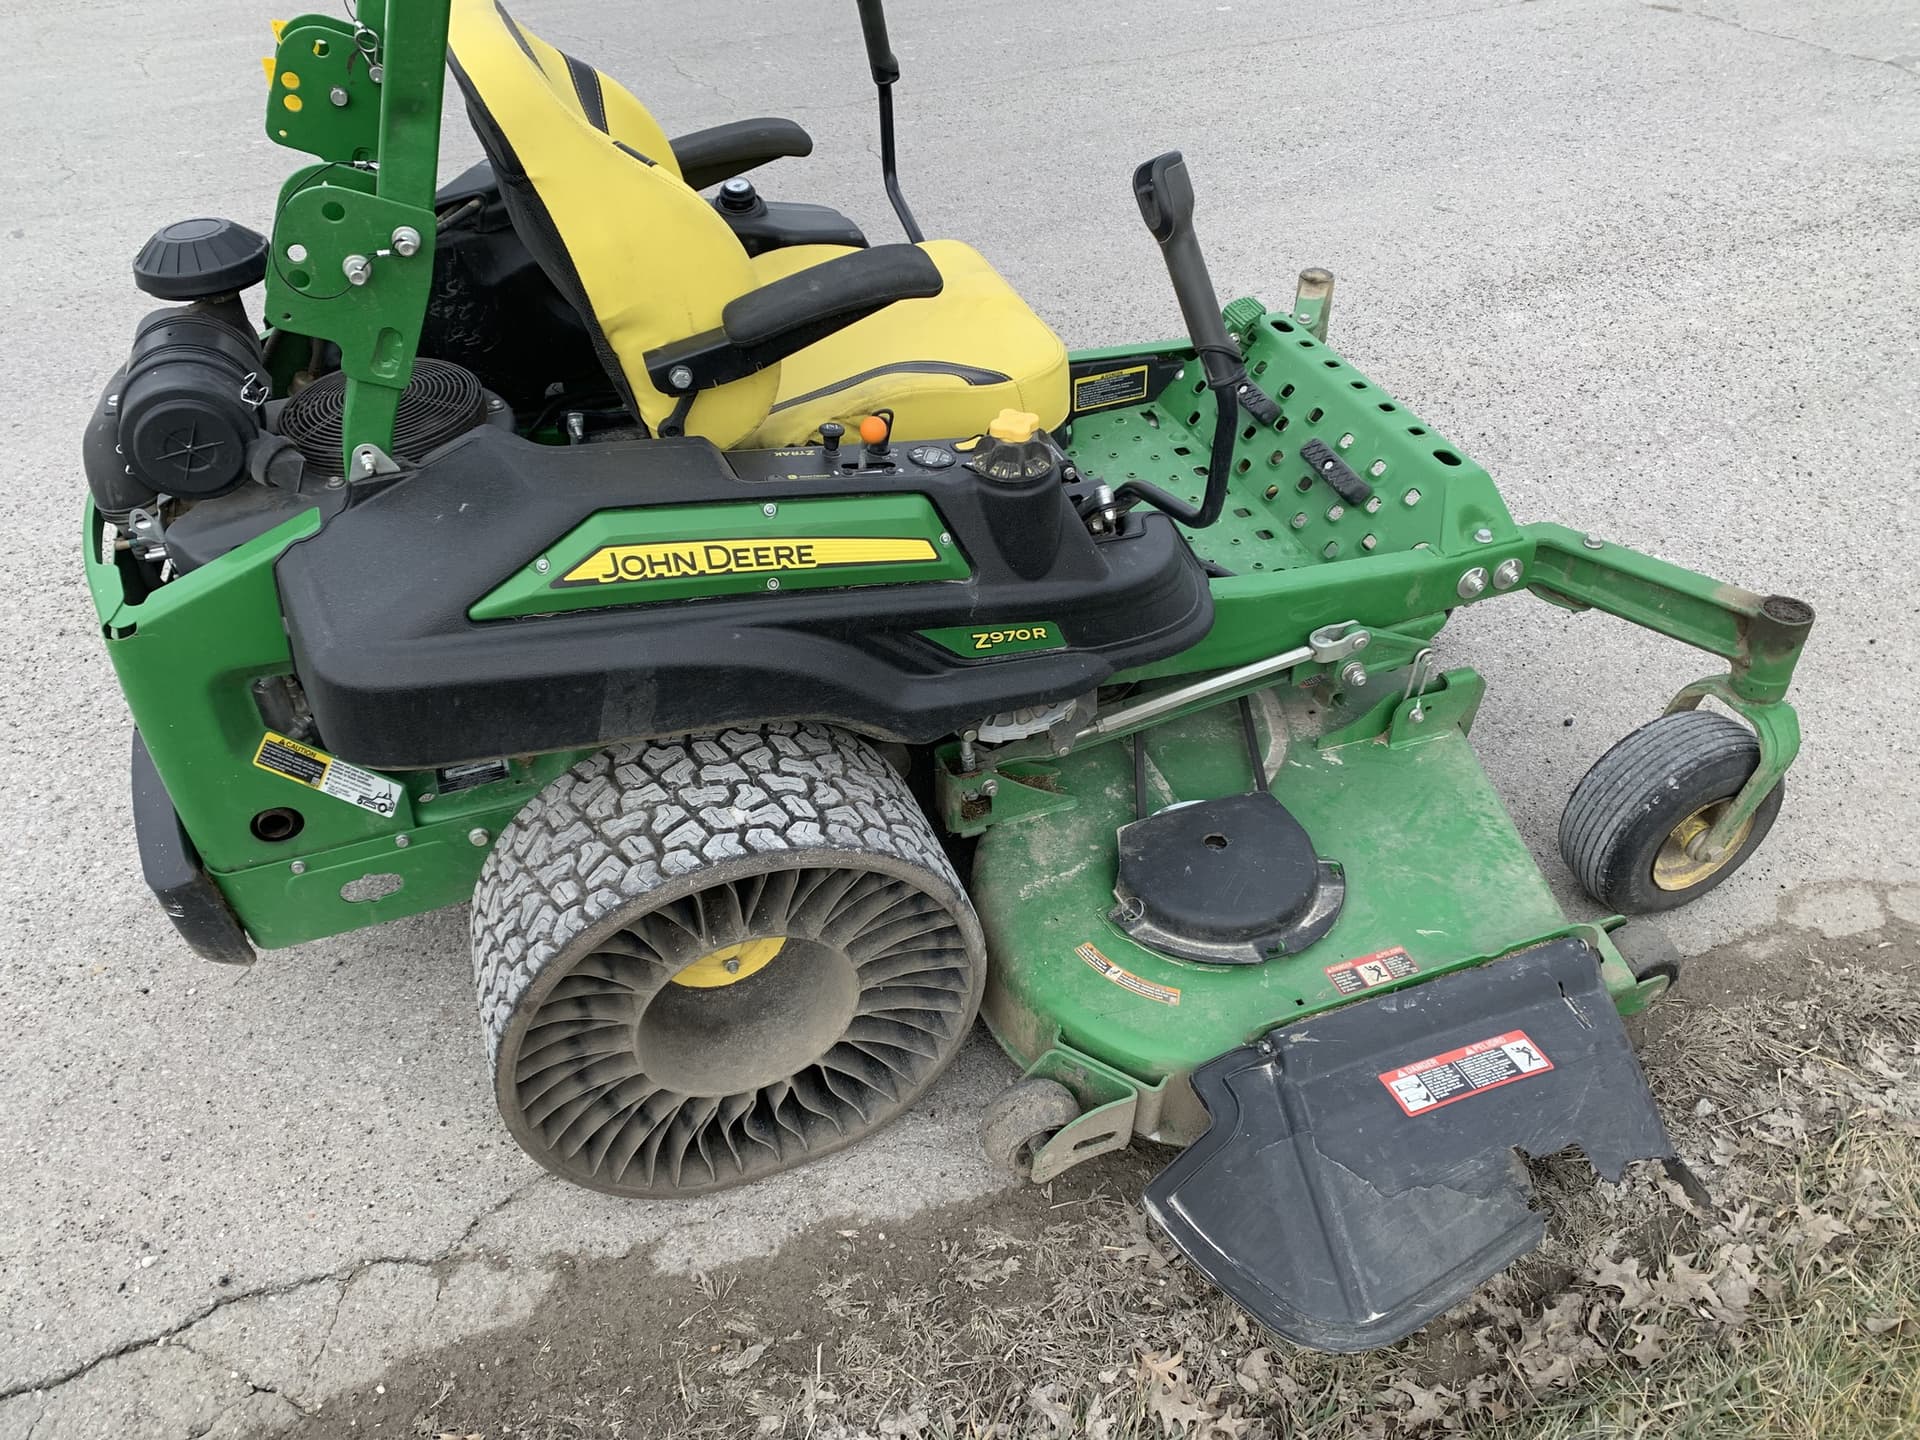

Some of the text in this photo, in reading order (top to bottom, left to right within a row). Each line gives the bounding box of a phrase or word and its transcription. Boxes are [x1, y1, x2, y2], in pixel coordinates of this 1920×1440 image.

[602, 544, 816, 579] JOHN DEERE
[286, 742, 317, 758] CAUTION
[1406, 1058, 1439, 1075] DANGER
